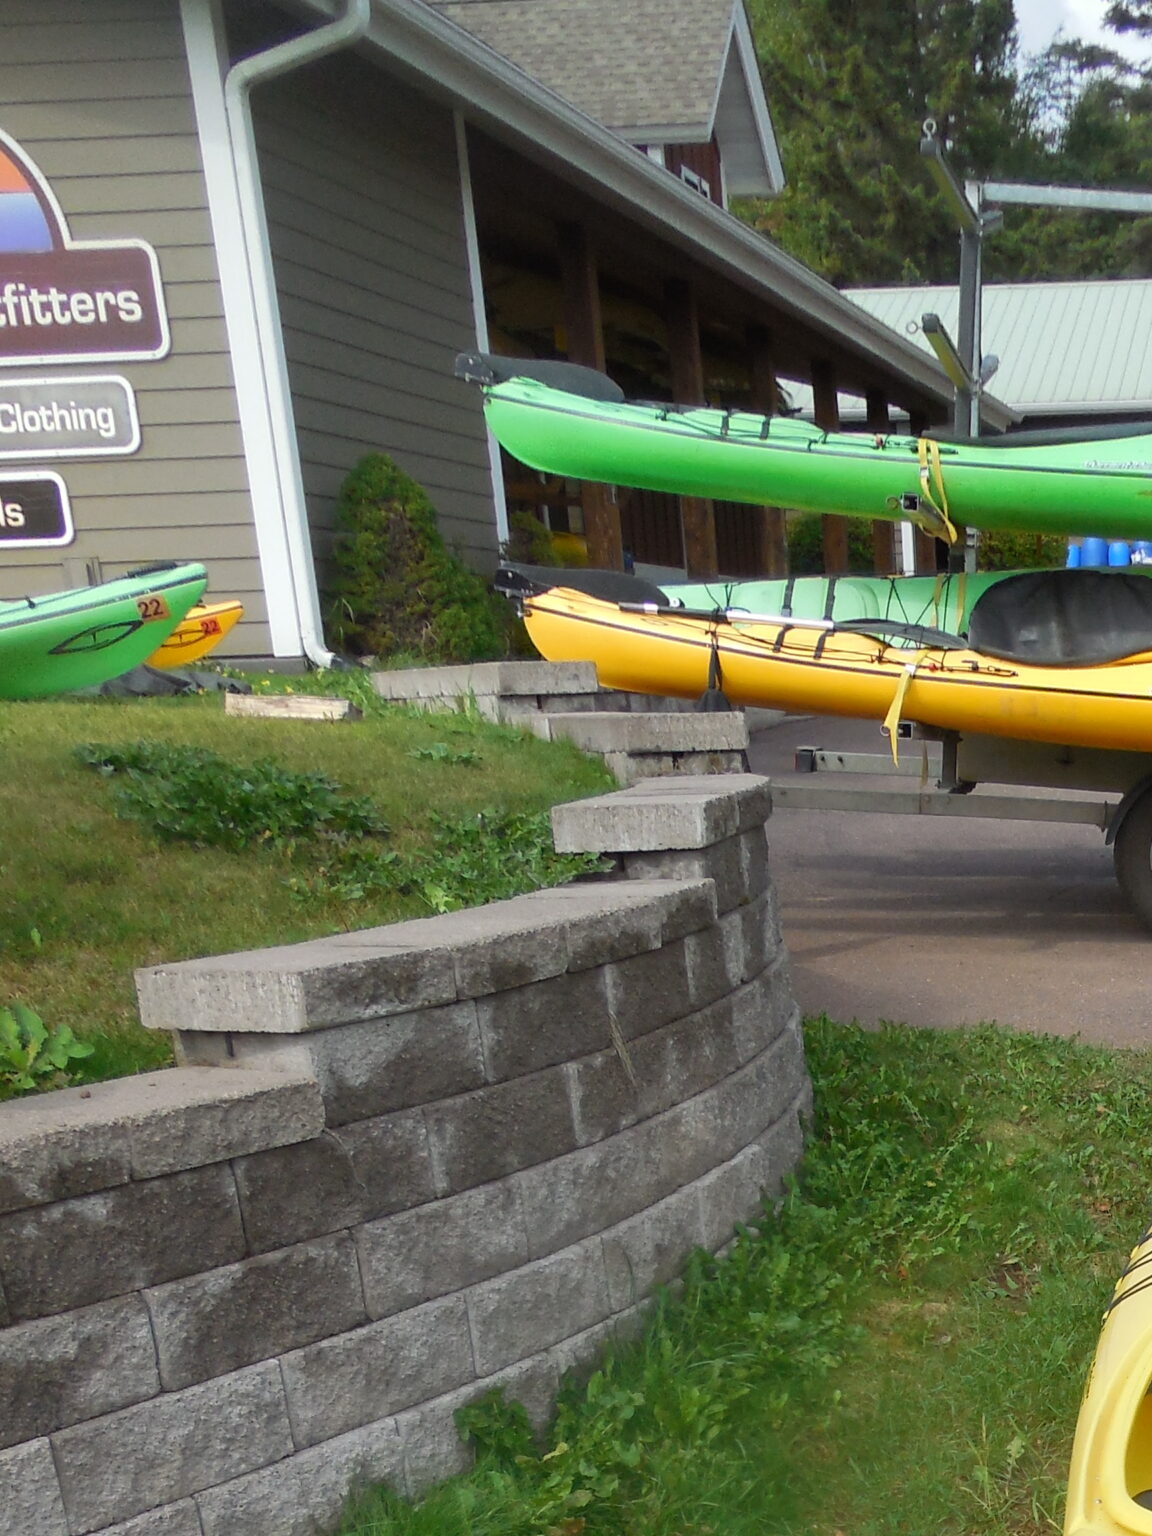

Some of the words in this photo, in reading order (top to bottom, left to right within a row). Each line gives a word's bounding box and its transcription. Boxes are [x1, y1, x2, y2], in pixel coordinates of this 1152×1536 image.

[0, 401, 116, 438] Clothing
[137, 598, 164, 619] 22
[201, 620, 220, 636] 22
